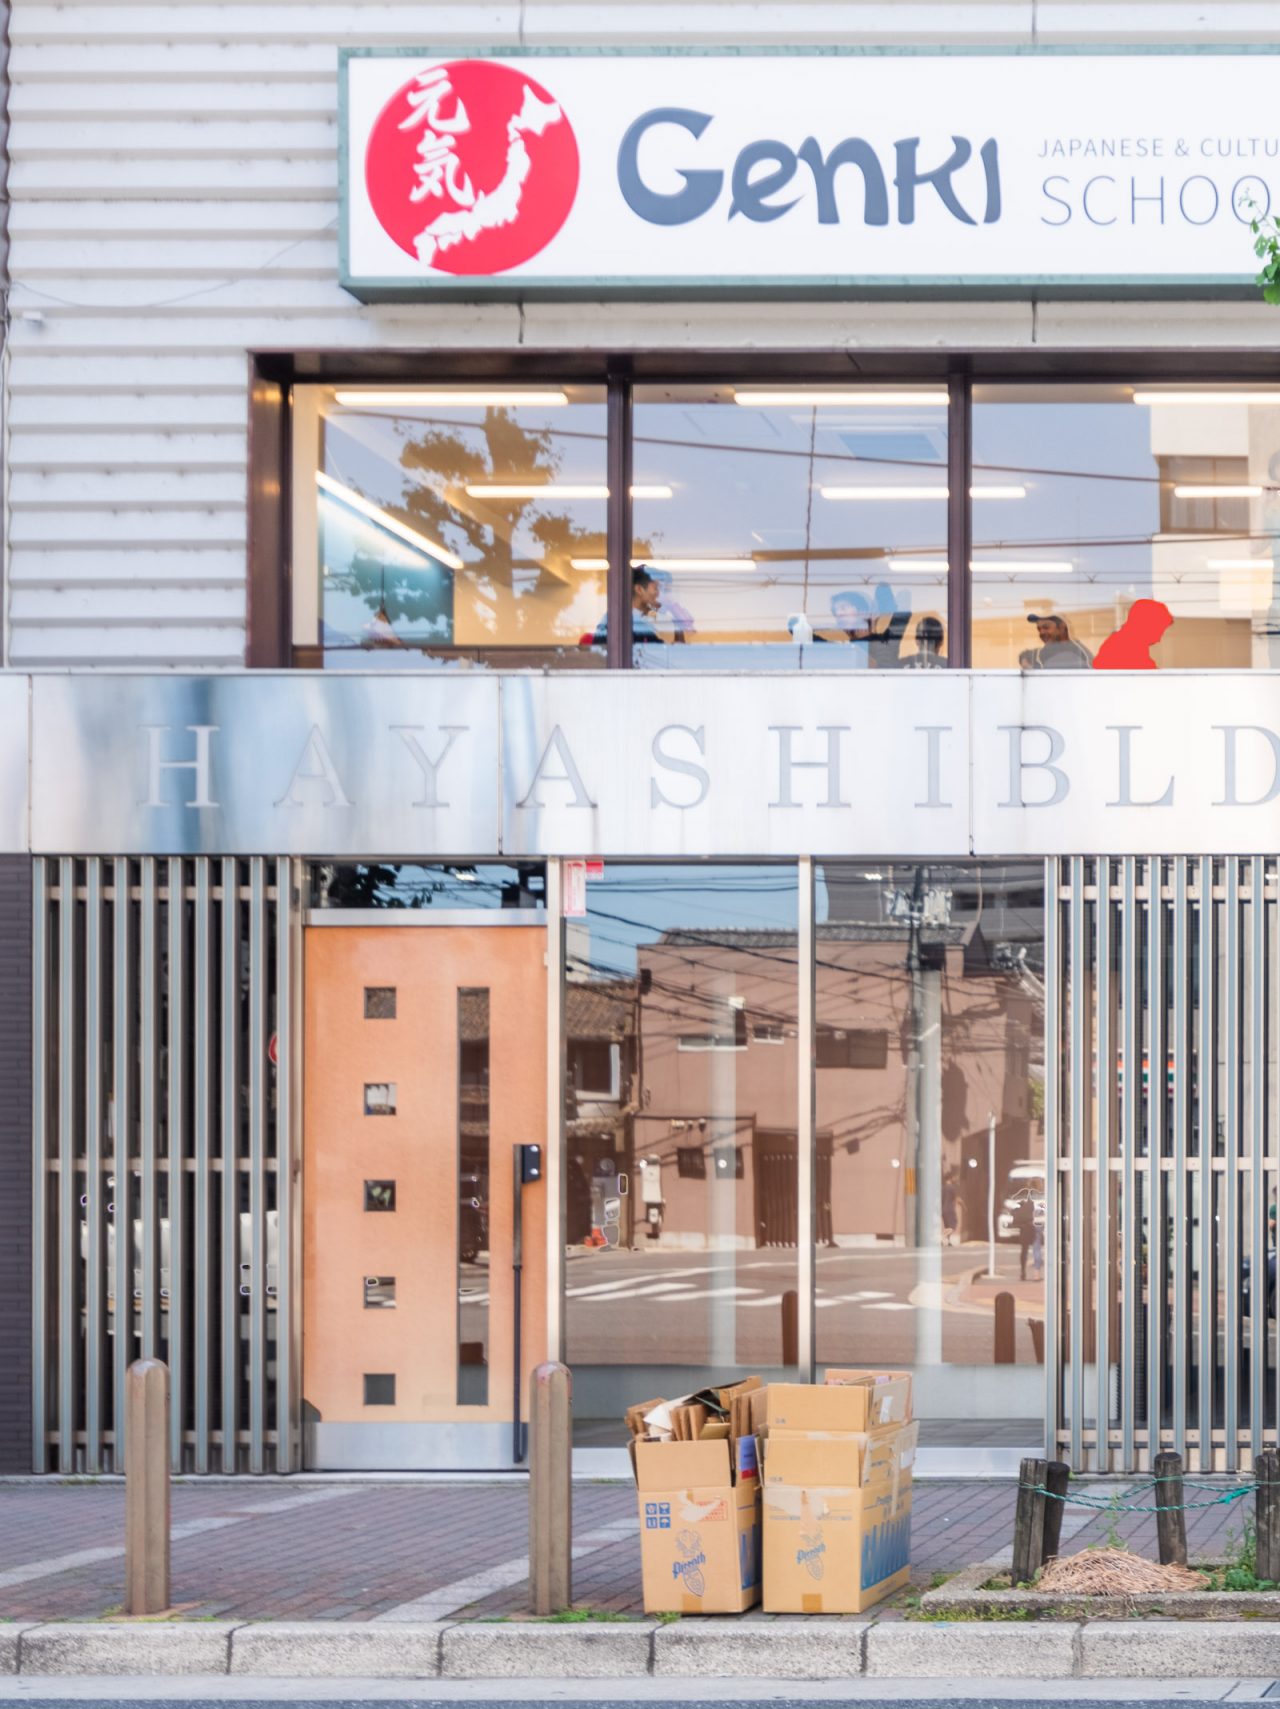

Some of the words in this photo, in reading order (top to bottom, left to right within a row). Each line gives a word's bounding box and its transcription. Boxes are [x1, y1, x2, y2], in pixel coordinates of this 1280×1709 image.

[397, 67, 472, 206] 元気
[1037, 137, 1164, 158] JAPANESE
[1174, 137, 1190, 157] &
